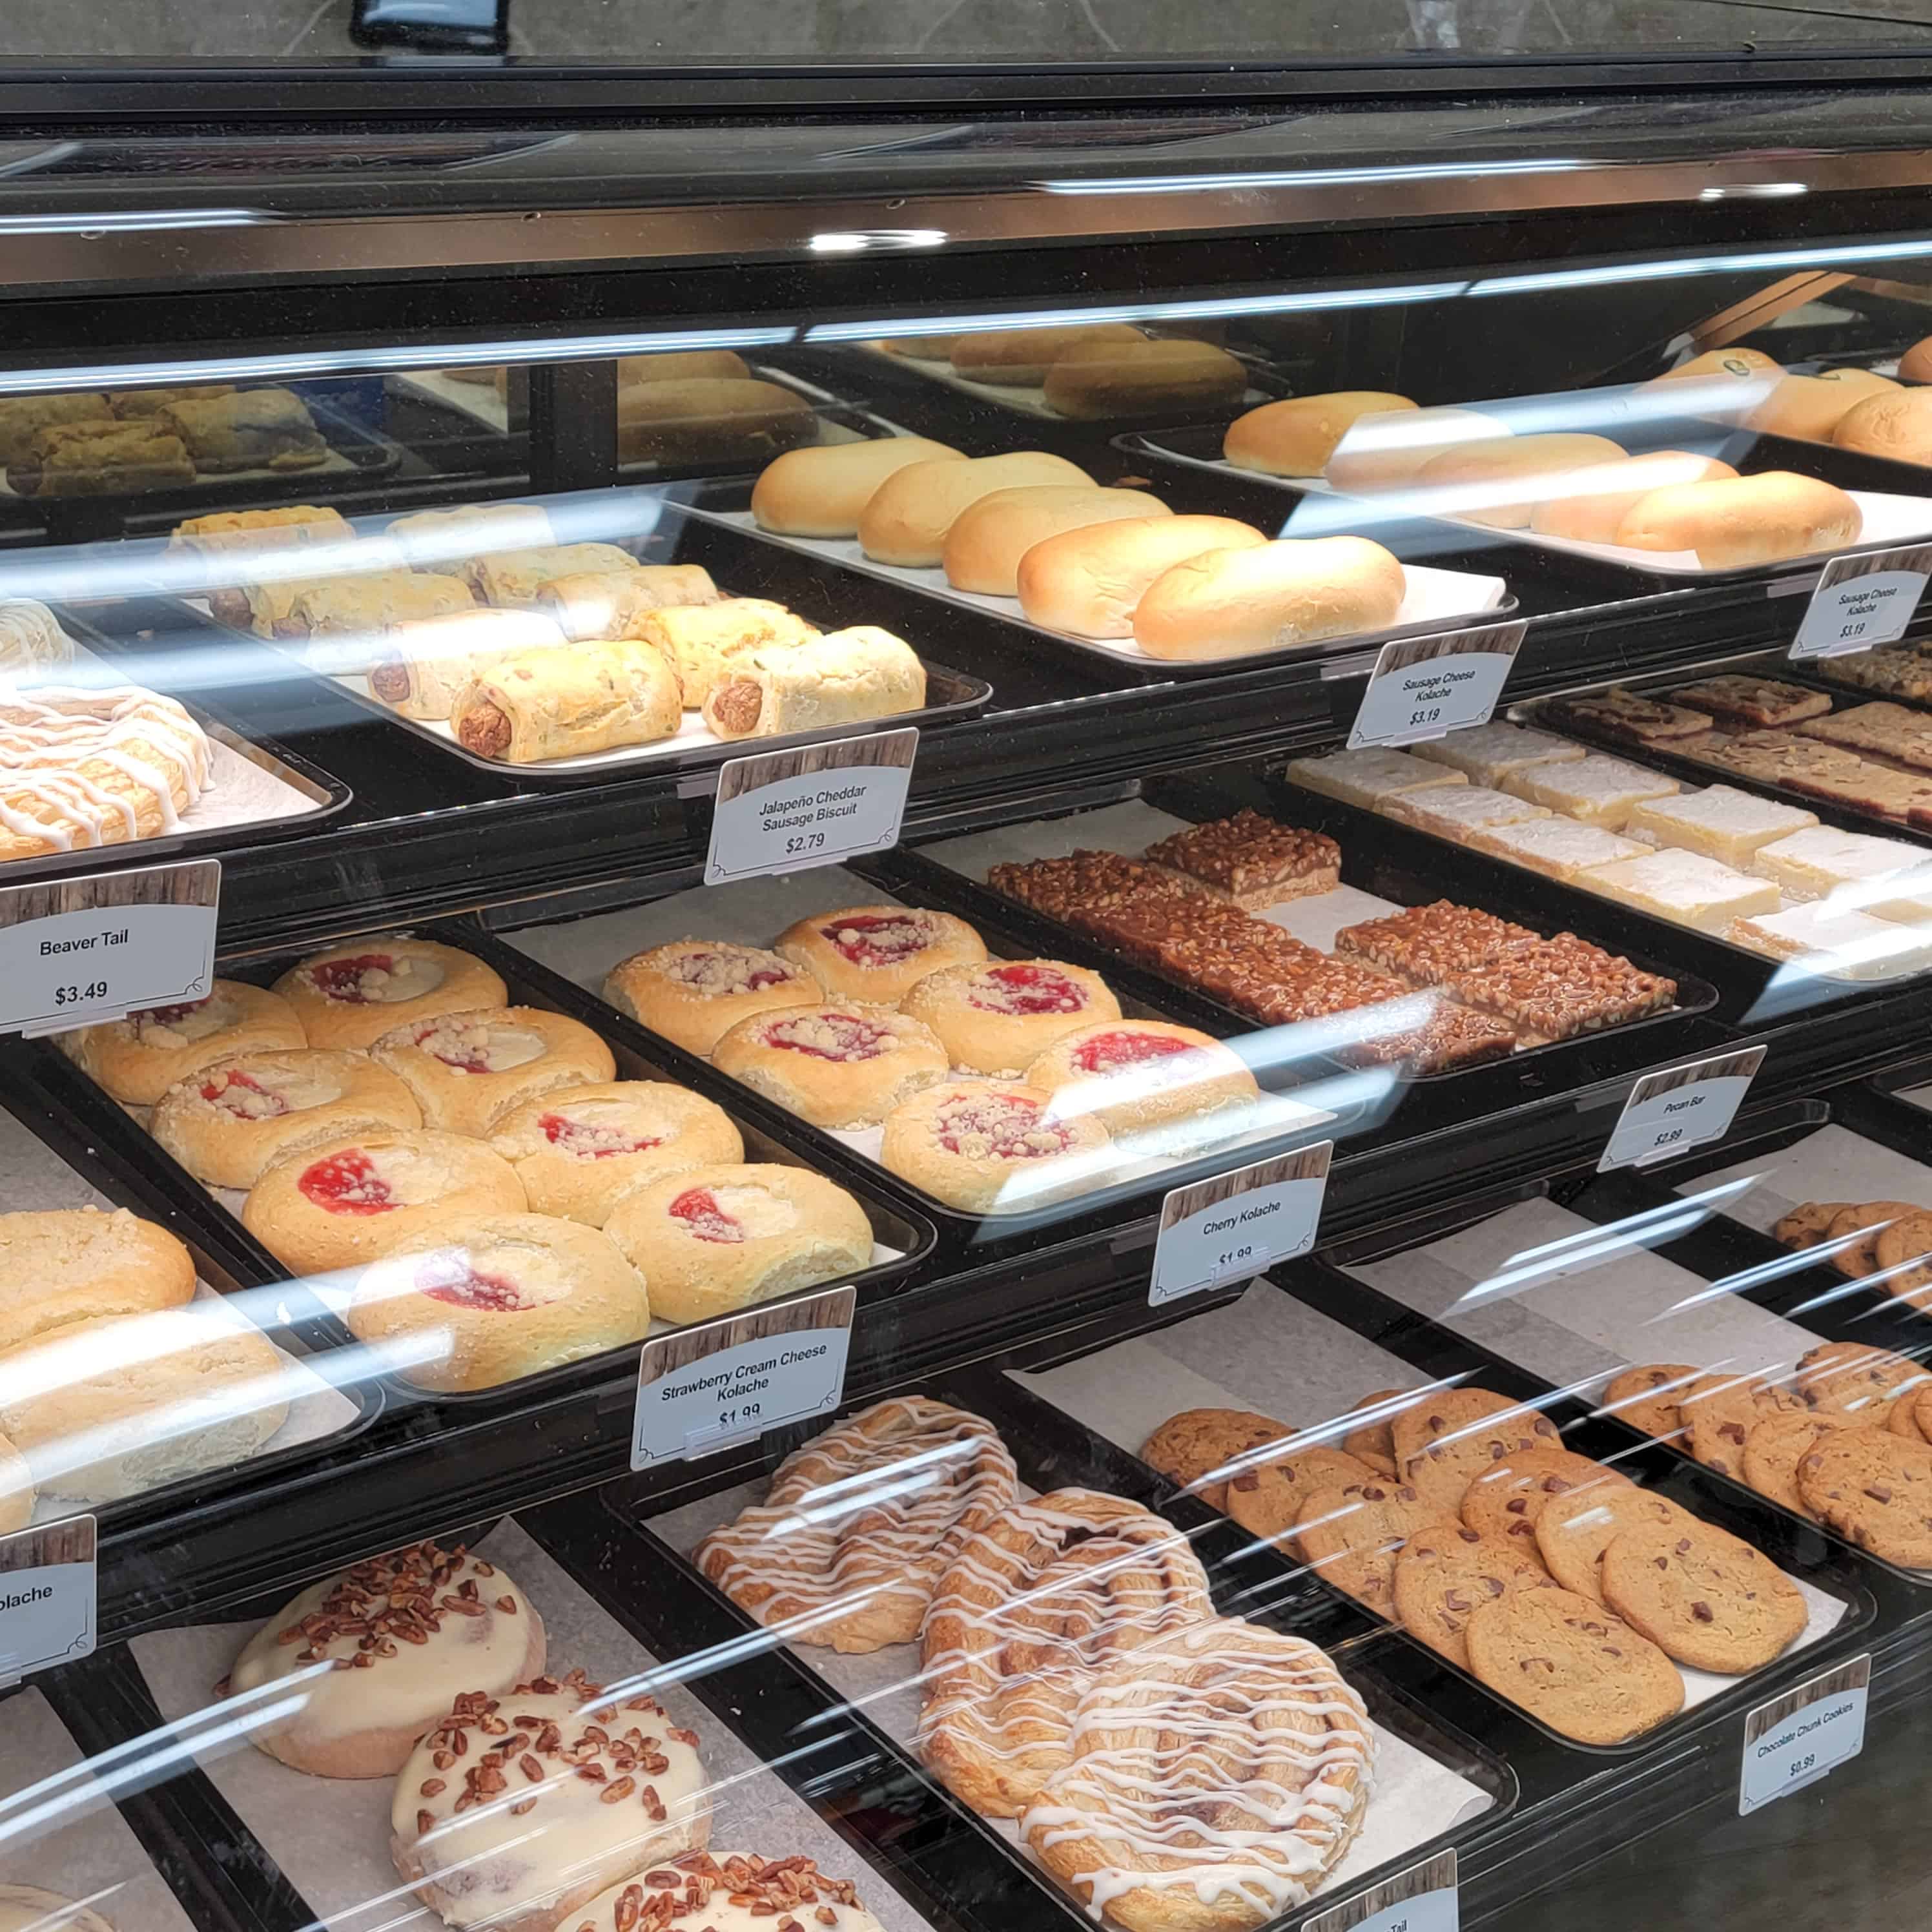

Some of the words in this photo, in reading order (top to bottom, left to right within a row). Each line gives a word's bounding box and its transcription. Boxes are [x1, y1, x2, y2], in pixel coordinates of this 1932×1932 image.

[1403, 675, 1441, 691] Sausage
[1443, 670, 1476, 684] Cheese
[1415, 688, 1452, 702] Kolache
[1410, 708, 1440, 725] $3.19
[759, 795, 813, 816] Jalapeño
[816, 785, 867, 805] Cheddar
[762, 813, 813, 832] Sausage
[816, 803, 857, 821] Biscuit
[786, 832, 825, 854] $2.79
[40, 936, 98, 956] Beaver
[101, 929, 128, 946] Tail
[55, 981, 107, 1006] $3.49
[1663, 1100, 1689, 1114] Pecan
[1690, 1096, 1705, 1107] Bar
[1654, 1129, 1683, 1146] $2.99
[1203, 1216, 1238, 1235] Cherry
[1240, 1200, 1280, 1223] Kolache
[1219, 1246, 1252, 1264] $199
[661, 1370, 732, 1401] Strawberry
[735, 1357, 776, 1379] Cream
[780, 1343, 827, 1366] Cheese
[717, 1377, 768, 1402] Kolache
[719, 1403, 760, 1424] $199
[1757, 1731, 1796, 1758] Chocolate
[1797, 1718, 1822, 1738] Chunk
[1823, 1702, 1854, 1723] Cookies
[1790, 1753, 1815, 1776] $0.99
